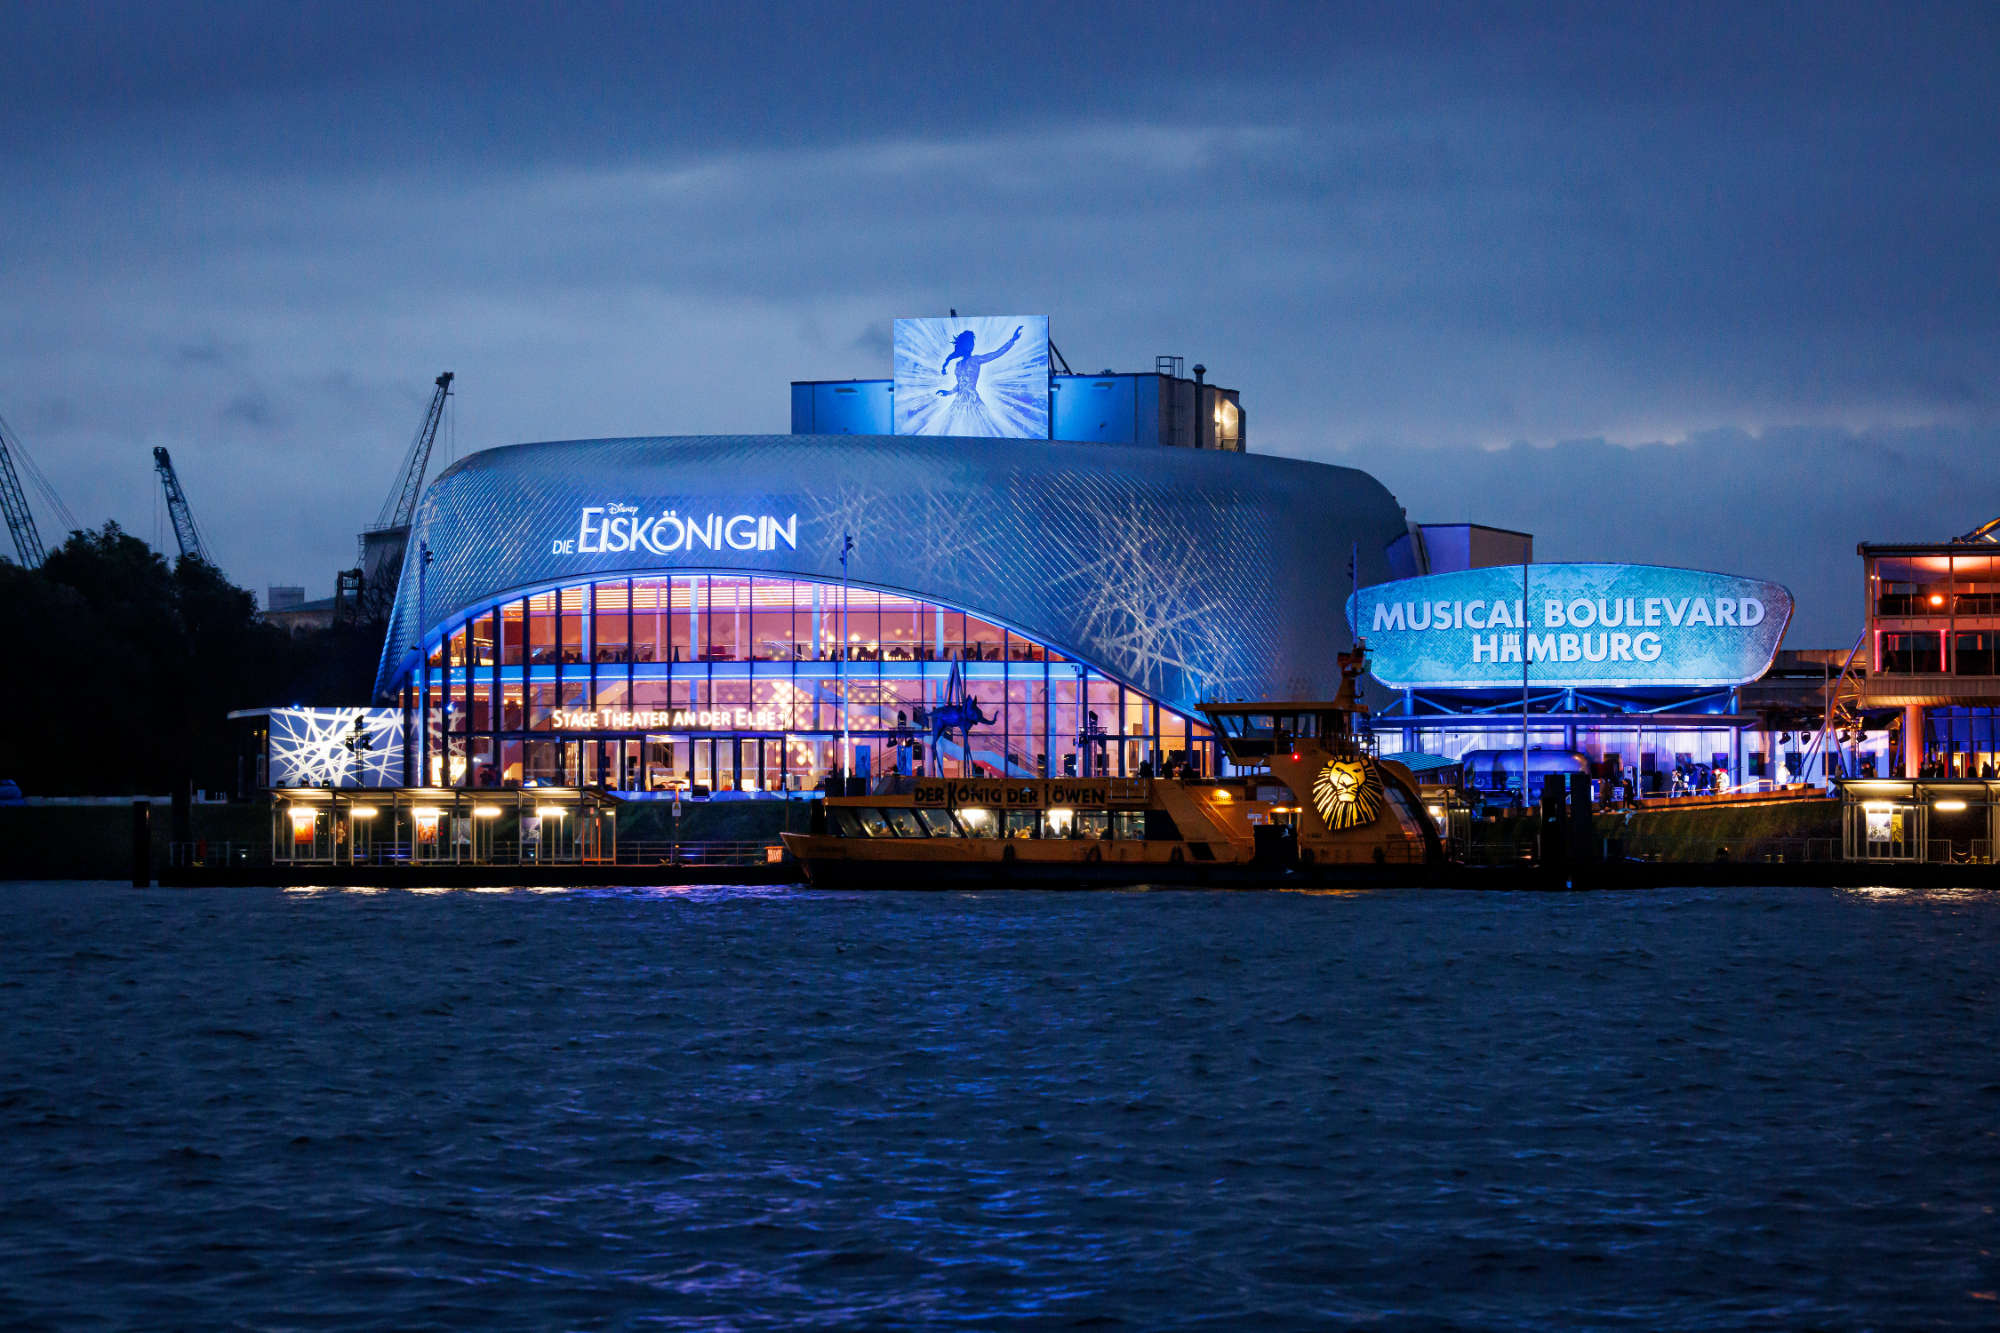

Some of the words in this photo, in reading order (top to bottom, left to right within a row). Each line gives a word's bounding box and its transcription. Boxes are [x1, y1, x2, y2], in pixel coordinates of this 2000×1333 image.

[552, 540, 575, 554] DIE
[578, 507, 797, 556] EISKÖNIGIN
[1373, 600, 1532, 632] MUSICAL
[1545, 597, 1766, 628] BOULEVARD
[1473, 632, 1662, 663] HAMBURG
[553, 709, 598, 728] STAGE
[601, 709, 669, 728] THEATER
[673, 711, 697, 727] AN
[700, 711, 731, 727] DER
[735, 708, 776, 727] ELBE
[914, 786, 945, 802] DER
[948, 780, 1001, 807] KÖNIG
[1007, 786, 1038, 802] DER
